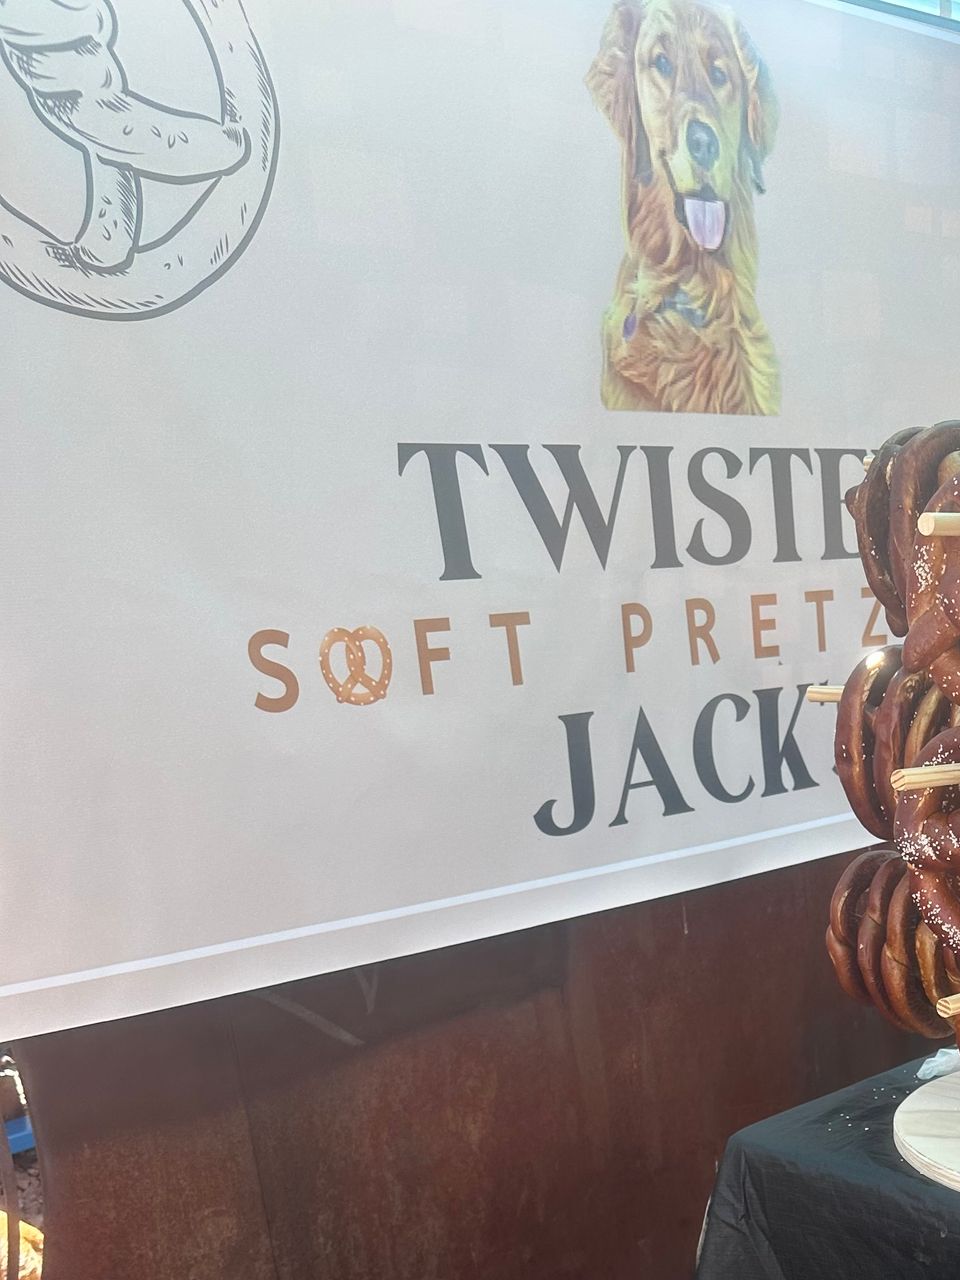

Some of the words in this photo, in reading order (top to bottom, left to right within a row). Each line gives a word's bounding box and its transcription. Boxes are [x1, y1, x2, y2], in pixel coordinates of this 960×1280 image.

[397, 442, 881, 582] TWISTE
[620, 587, 888, 674] PRETZ
[533, 680, 838, 838] JACK
